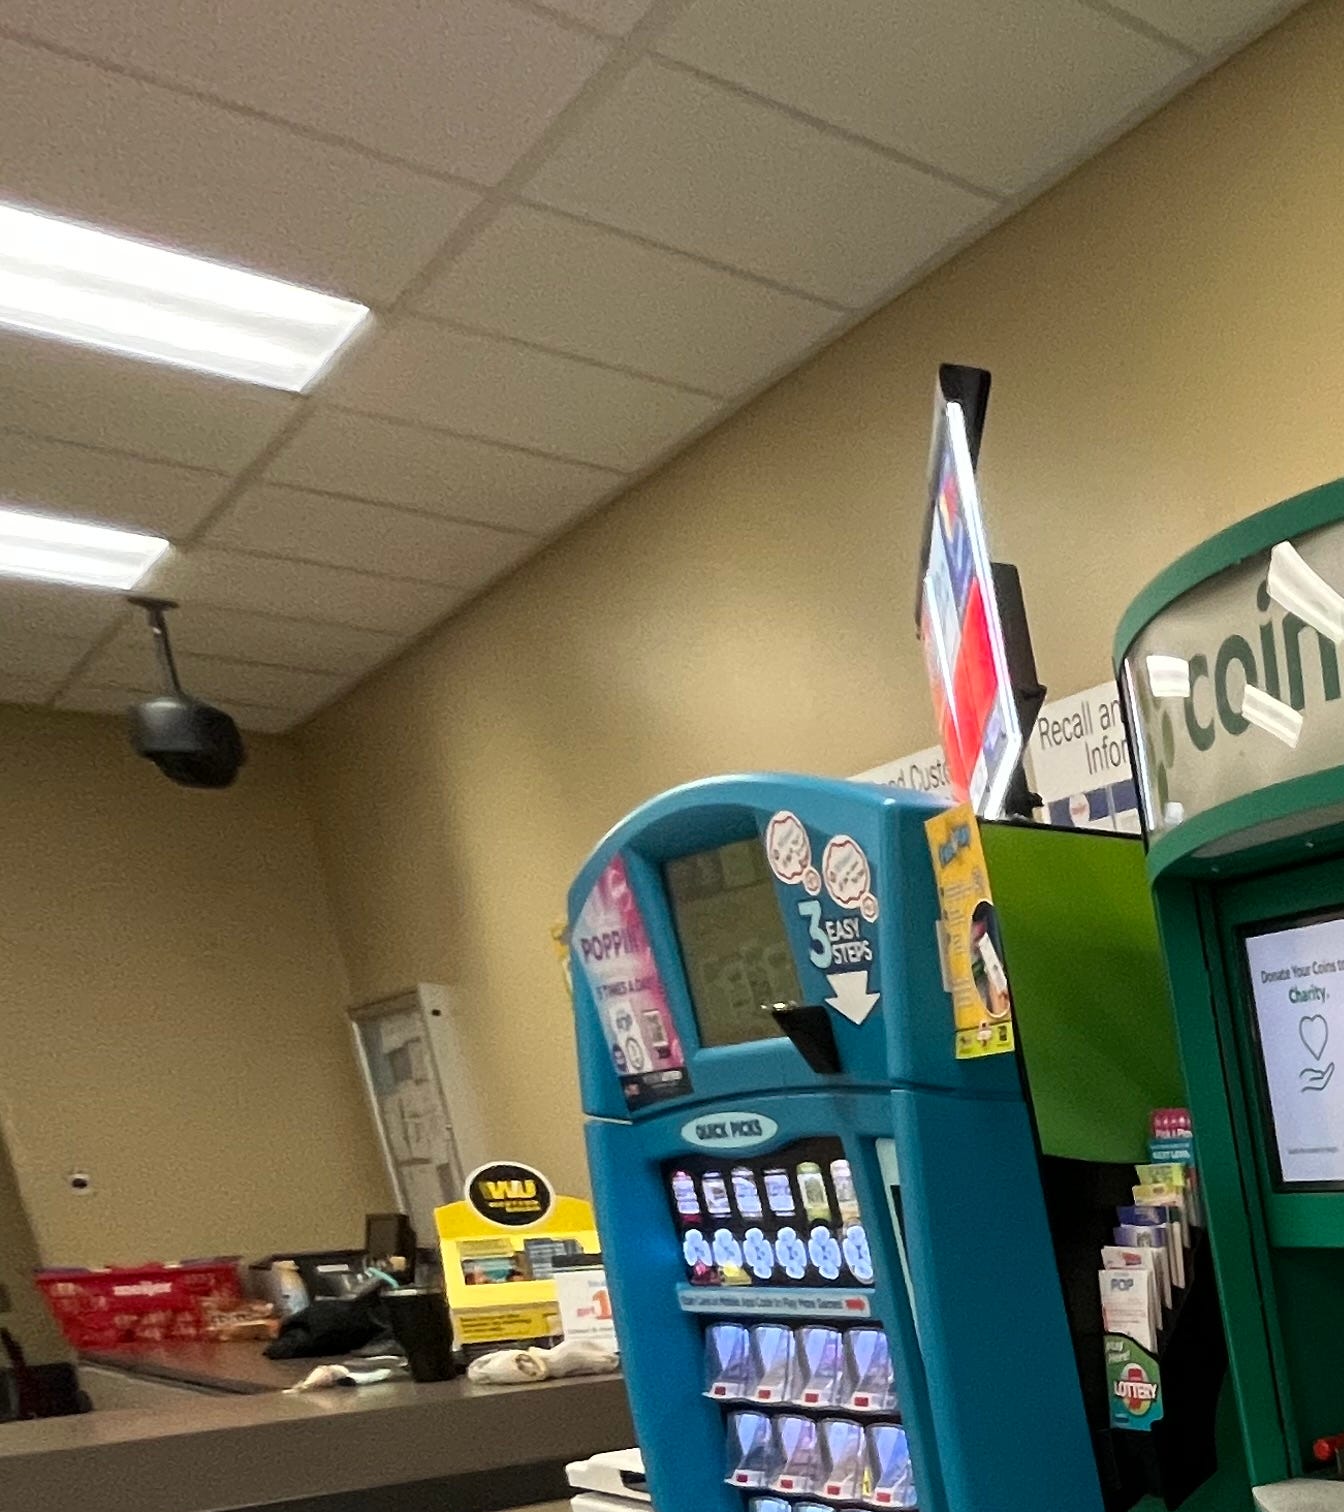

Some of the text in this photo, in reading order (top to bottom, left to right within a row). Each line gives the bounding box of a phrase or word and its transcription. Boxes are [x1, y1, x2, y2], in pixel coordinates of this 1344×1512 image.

[1038, 698, 1124, 750] Recall an
[1084, 736, 1129, 775] Infor
[798, 900, 860, 968] 3 EASY
[832, 940, 873, 965] STEPS
[1261, 966, 1291, 984] Donate
[1291, 964, 1311, 980] Your
[1312, 961, 1338, 976] Coins
[696, 1118, 763, 1140] QUICK PICKS
[1113, 1380, 1158, 1401] LOTTERY
